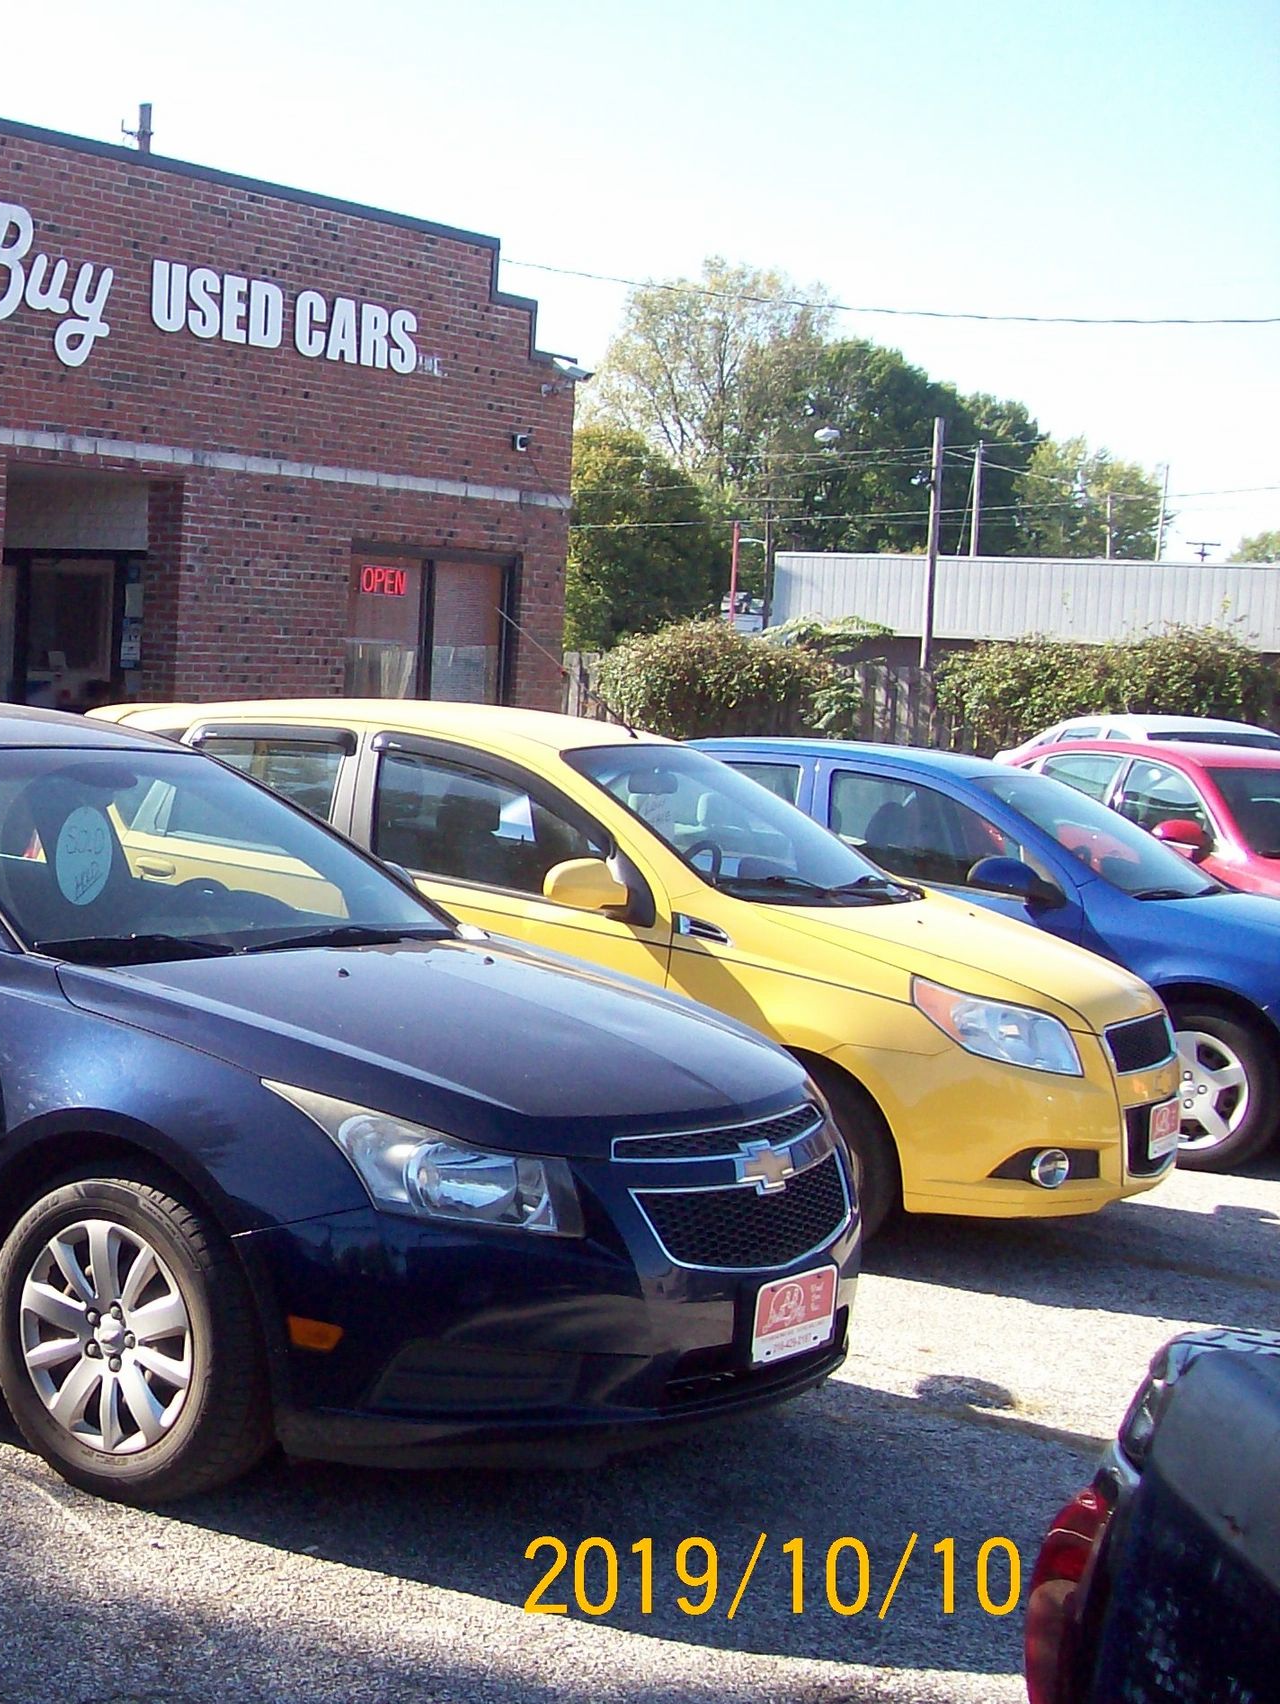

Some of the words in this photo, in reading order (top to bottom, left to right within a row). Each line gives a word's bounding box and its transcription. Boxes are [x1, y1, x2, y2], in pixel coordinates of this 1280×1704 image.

[151, 259, 284, 350] USED
[294, 289, 418, 375] CARS
[363, 567, 407, 595] OPEN
